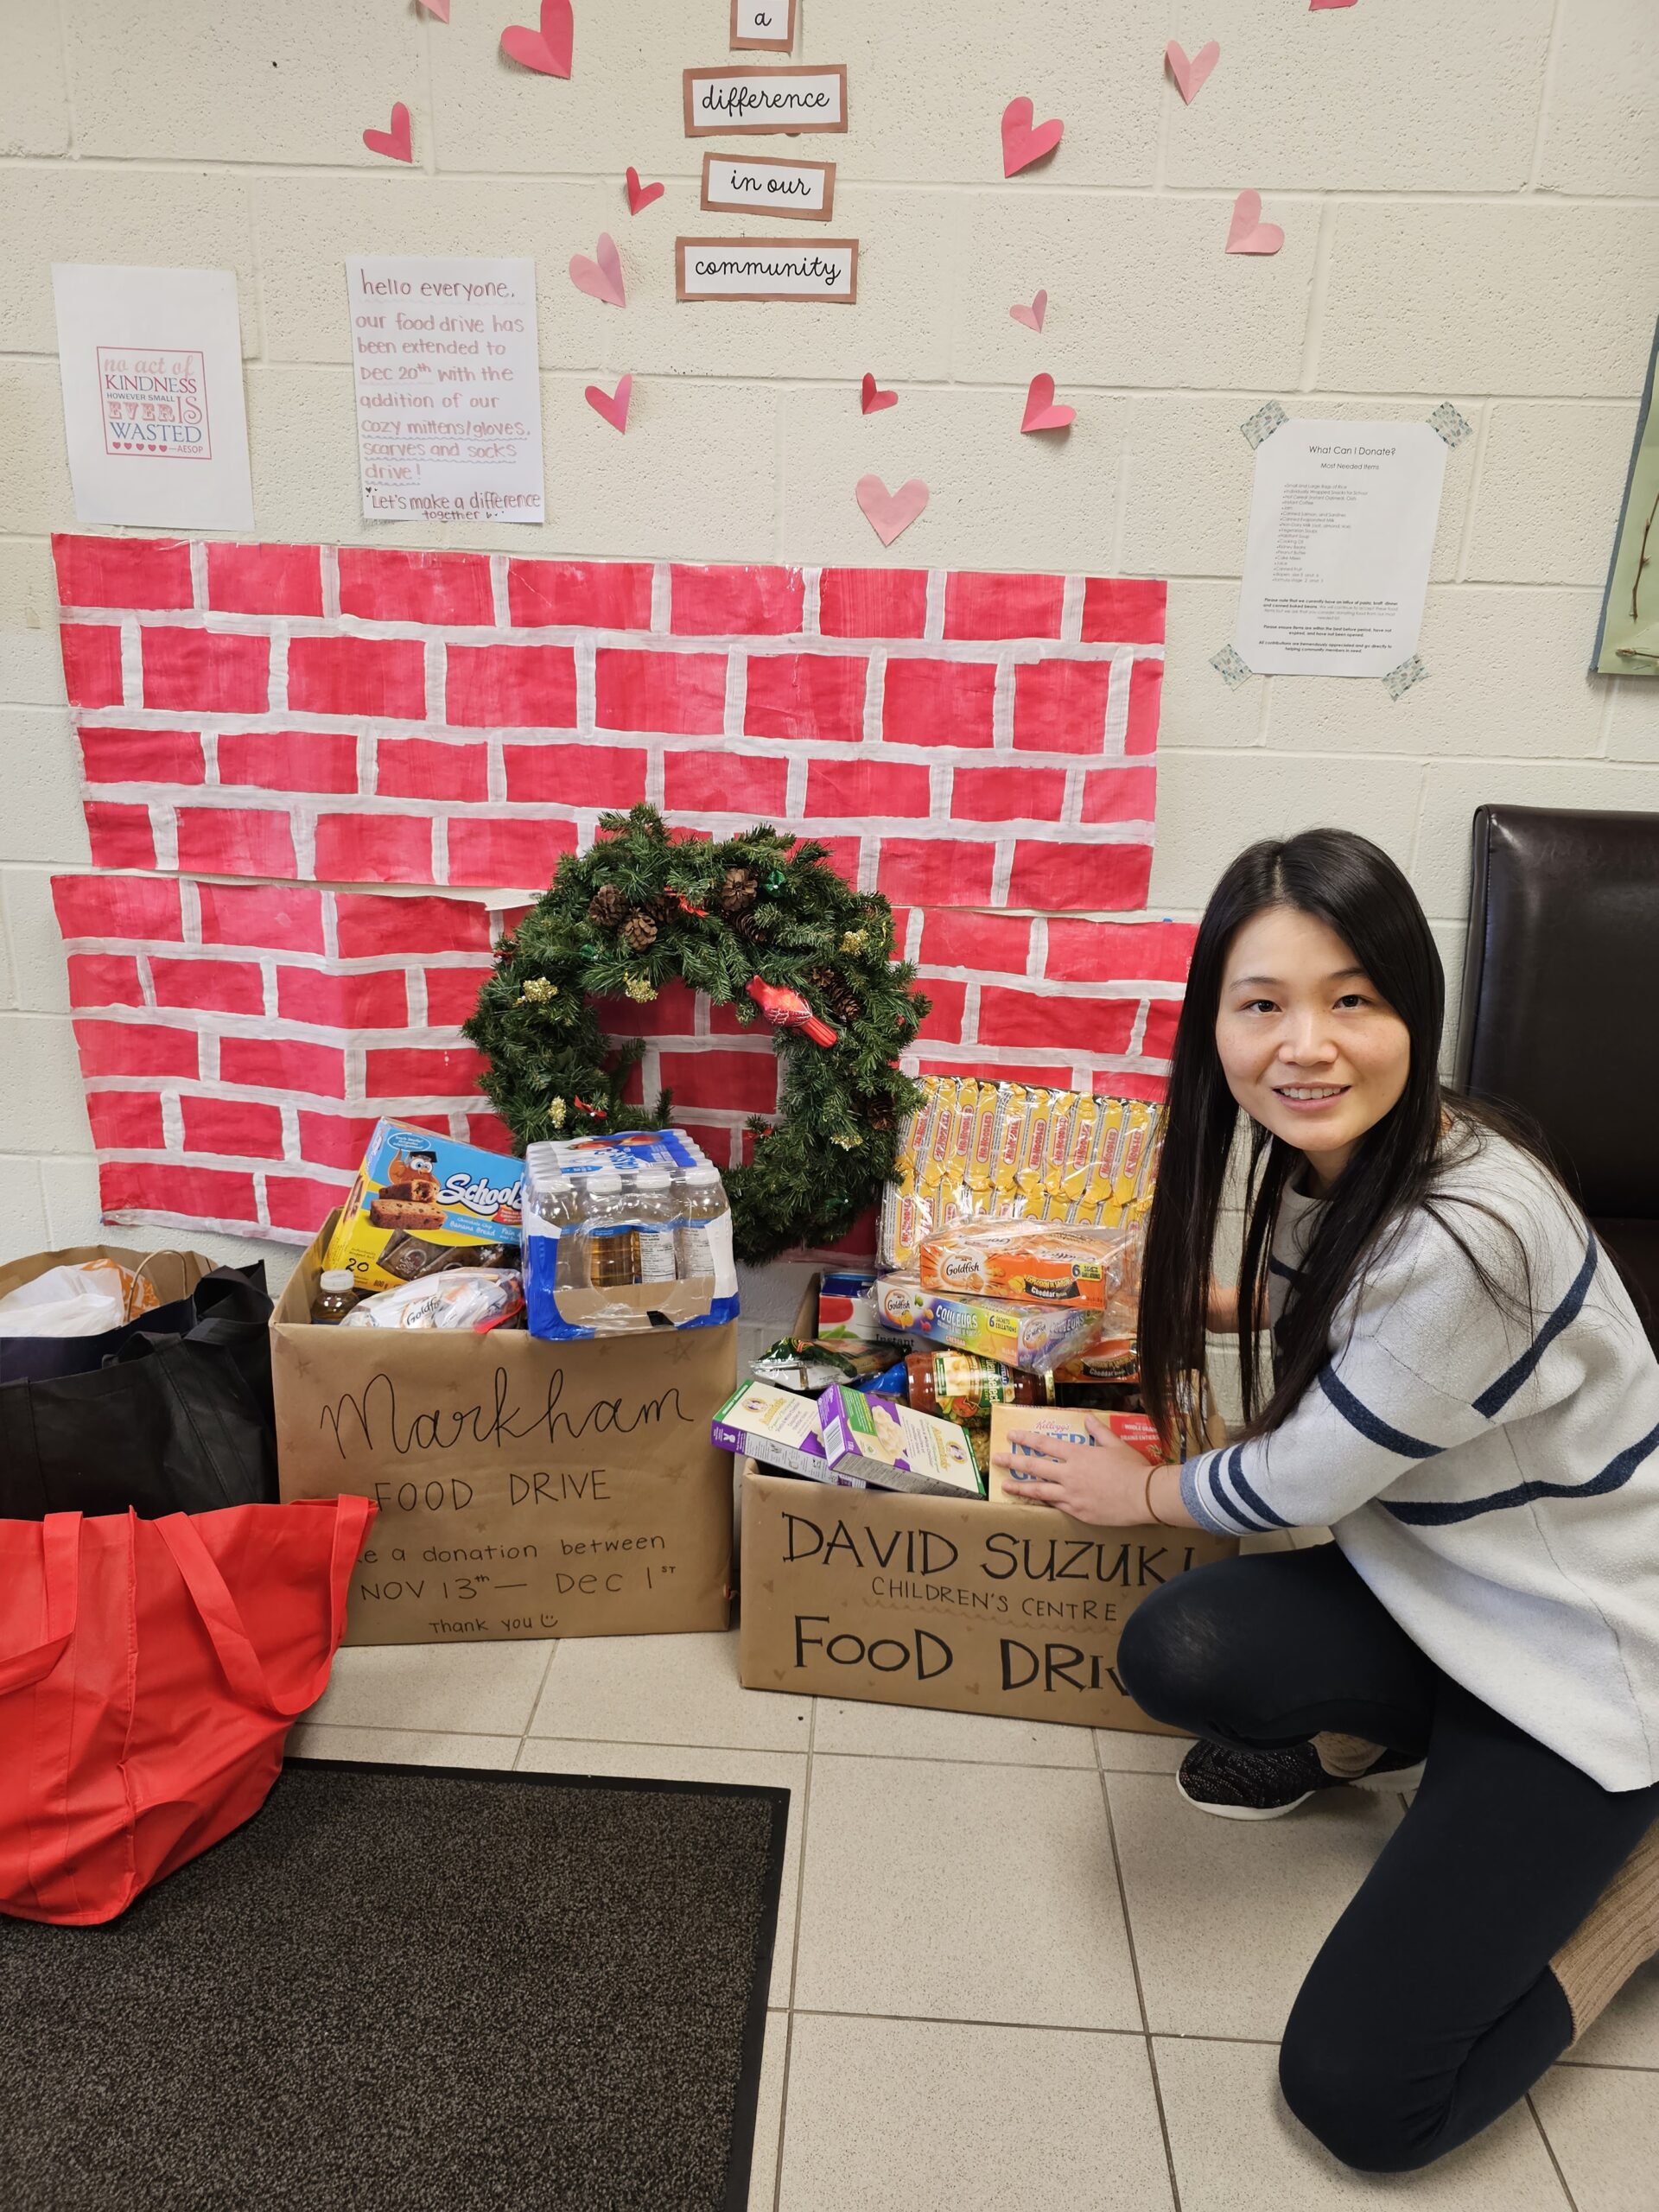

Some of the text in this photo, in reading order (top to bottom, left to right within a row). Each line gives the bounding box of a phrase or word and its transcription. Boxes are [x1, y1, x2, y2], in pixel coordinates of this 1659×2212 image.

[754, 11, 772, 27] a
[702, 85, 830, 118] difference
[731, 169, 811, 196] in our
[695, 257, 842, 286] community
[360, 269, 411, 296] hello
[355, 312, 524, 333] our food drive has
[357, 337, 505, 355] been extended to
[104, 354, 195, 378] no act of
[360, 362, 513, 382] Dec 20th with the
[105, 374, 197, 394] KINDNESS
[106, 392, 175, 403] HOWEVER SMALL
[359, 392, 500, 409] addition of our
[107, 401, 175, 423] EVER
[176, 396, 203, 425] IS
[110, 422, 202, 443] WASTED
[361, 420, 401, 435] cozy
[363, 442, 517, 459] scarves and socks
[1308, 445, 1332, 454] What
[1333, 446, 1352, 455] Can
[1358, 447, 1396, 456] Donate?
[365, 463, 421, 480] drive!
[372, 491, 541, 511] Let's make a difference
[423, 510, 480, 520] together
[449, 1221, 474, 1231] Banana
[476, 1227, 496, 1236] Bread
[346, 1258, 369, 1272] 20
[945, 1261, 980, 1276] Goldfish
[1072, 1264, 1080, 1277] 6
[1031, 1286, 1055, 1298] Cheddar
[887, 1299, 911, 1311] Goldfish
[936, 1305, 978, 1328] COULEURS
[988, 1315, 995, 1327] 6
[320, 1367, 694, 1459] Markham
[375, 1469, 611, 1512] FOOD DRIVE
[391, 1547, 406, 1562] a
[423, 1541, 538, 1563] donation
[561, 1534, 665, 1555] between
[781, 1511, 959, 1576] DAVID
[360, 1580, 425, 1601] NOV
[442, 1573, 490, 1600] 13th
[871, 1576, 1118, 1623] CHILDREN'S CENTRE
[429, 1617, 533, 1635] Thank you
[793, 1614, 954, 1681] FOOD
